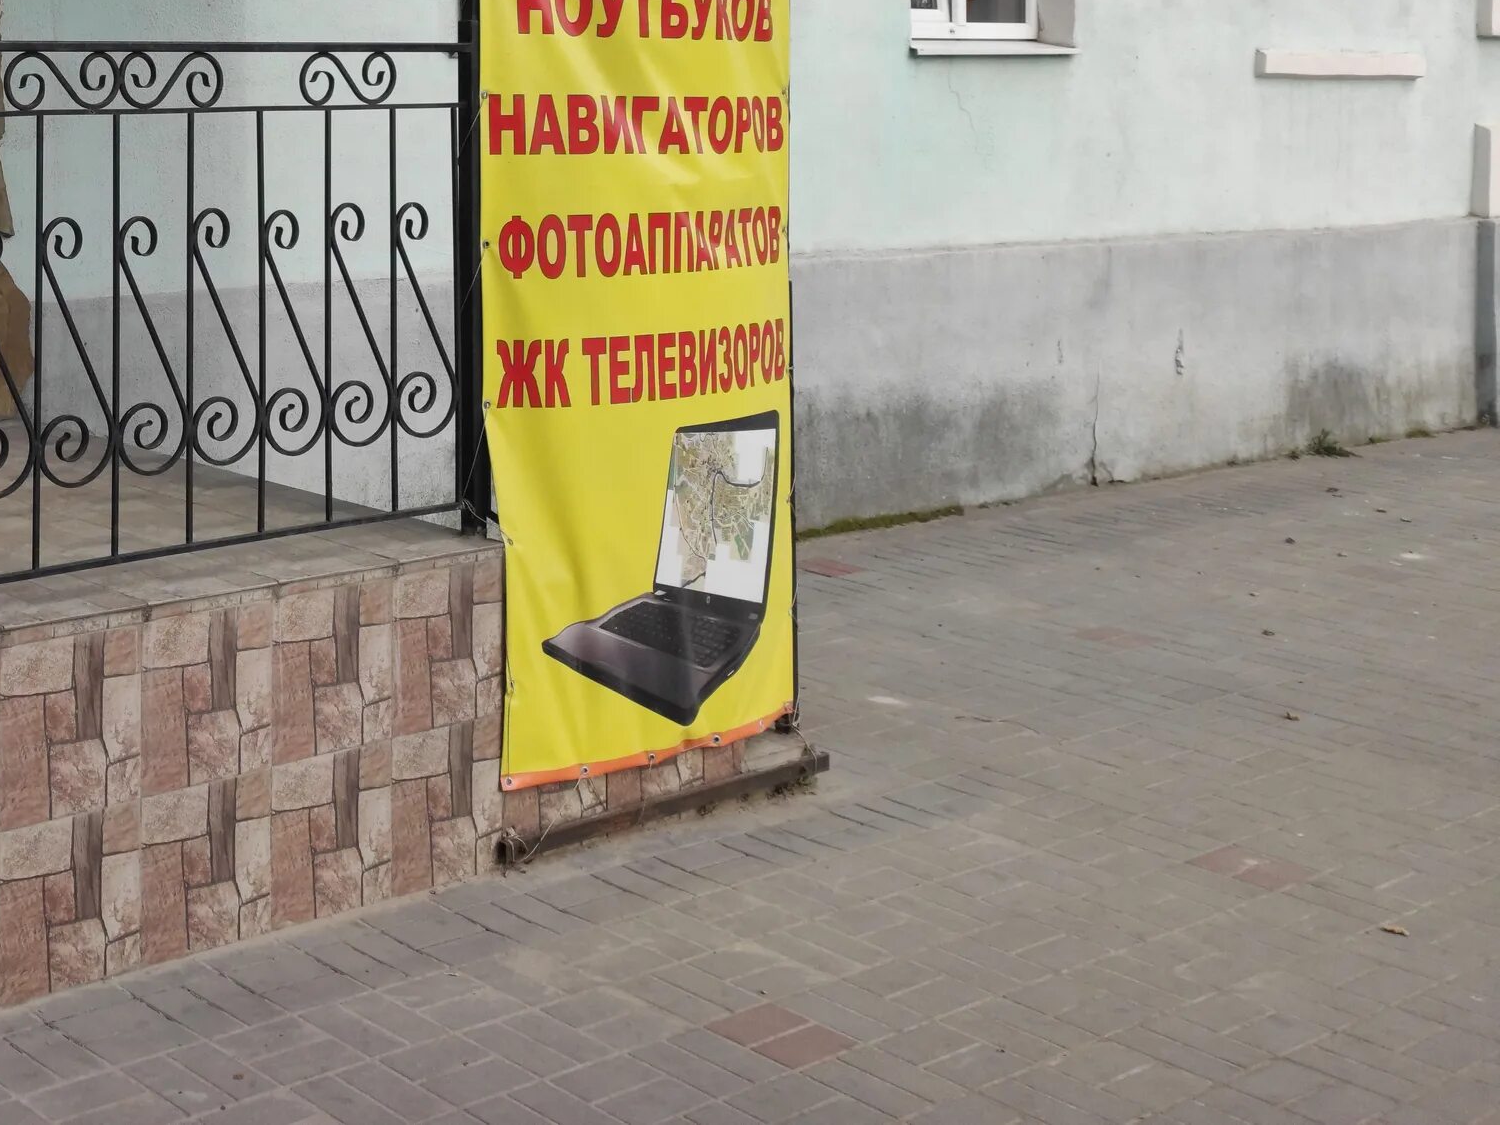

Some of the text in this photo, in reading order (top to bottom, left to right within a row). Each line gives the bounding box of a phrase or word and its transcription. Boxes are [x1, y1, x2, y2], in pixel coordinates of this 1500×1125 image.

[488, 93, 784, 156] НАВИГАТОРОВ
[498, 205, 781, 279] ФОТОАППАРАТОВ
[496, 318, 785, 409] ЖК ТЕЛЕВИЗОРОВ
